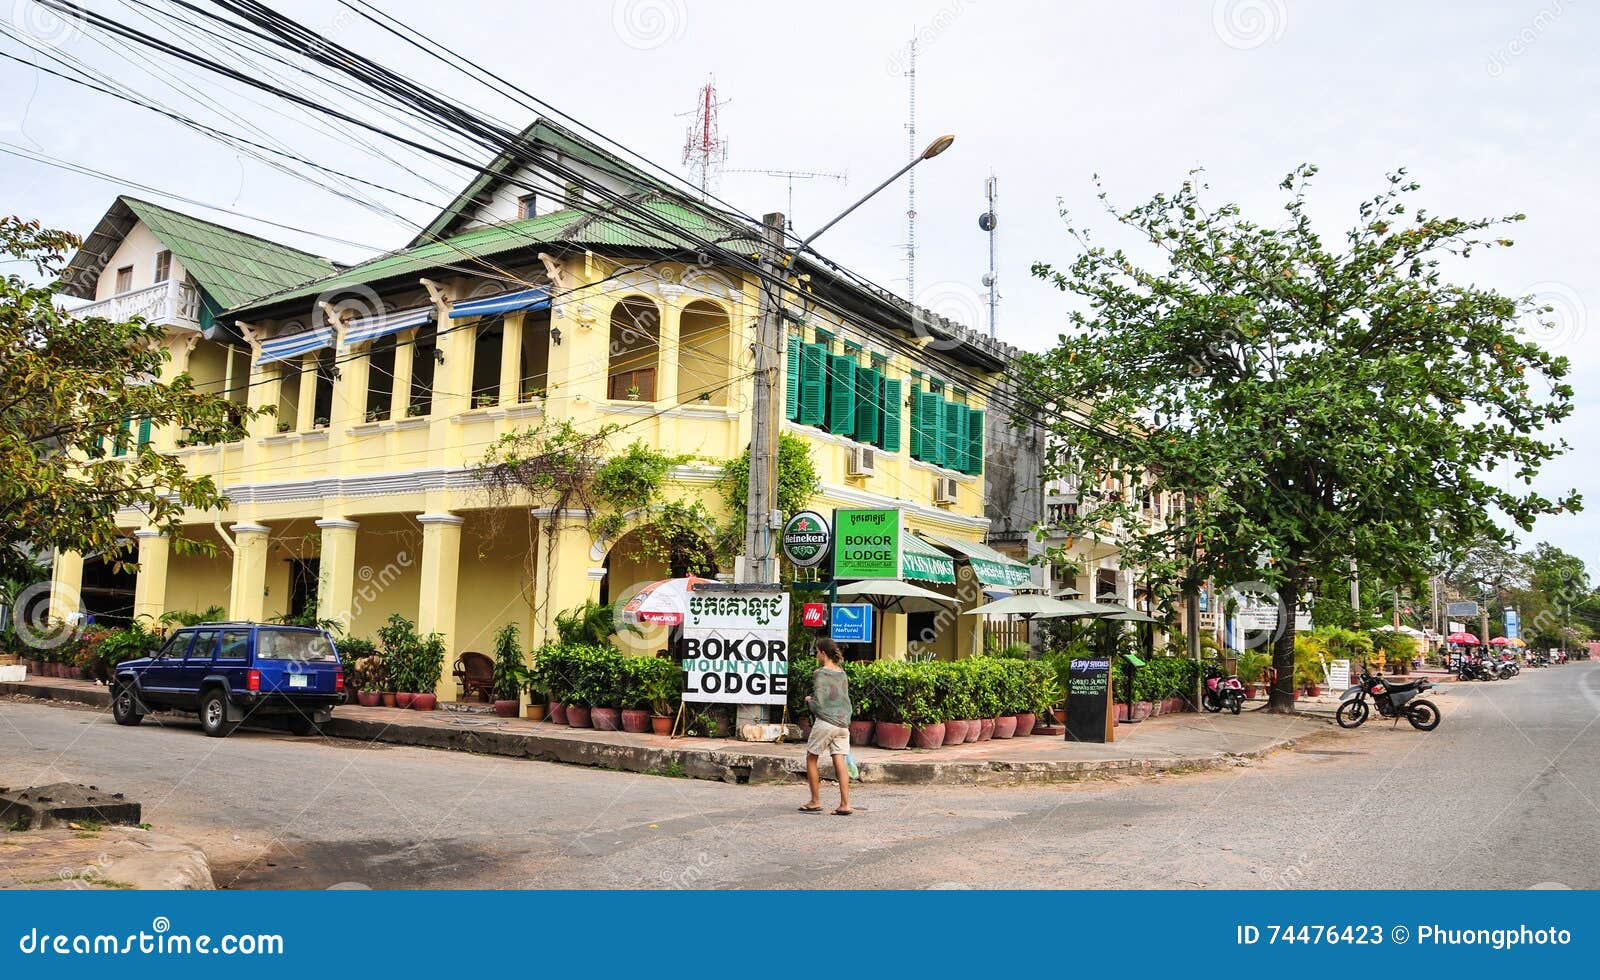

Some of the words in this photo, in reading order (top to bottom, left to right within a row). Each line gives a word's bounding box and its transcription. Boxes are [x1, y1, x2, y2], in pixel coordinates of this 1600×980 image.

[785, 533, 825, 544] Heineken
[845, 535, 892, 546] BOKOR
[845, 550, 892, 561] LODGE
[805, 608, 821, 624] illy
[682, 638, 787, 662] BOKOR
[682, 658, 789, 674] MOUNTAIN
[682, 671, 788, 696] LODGE
